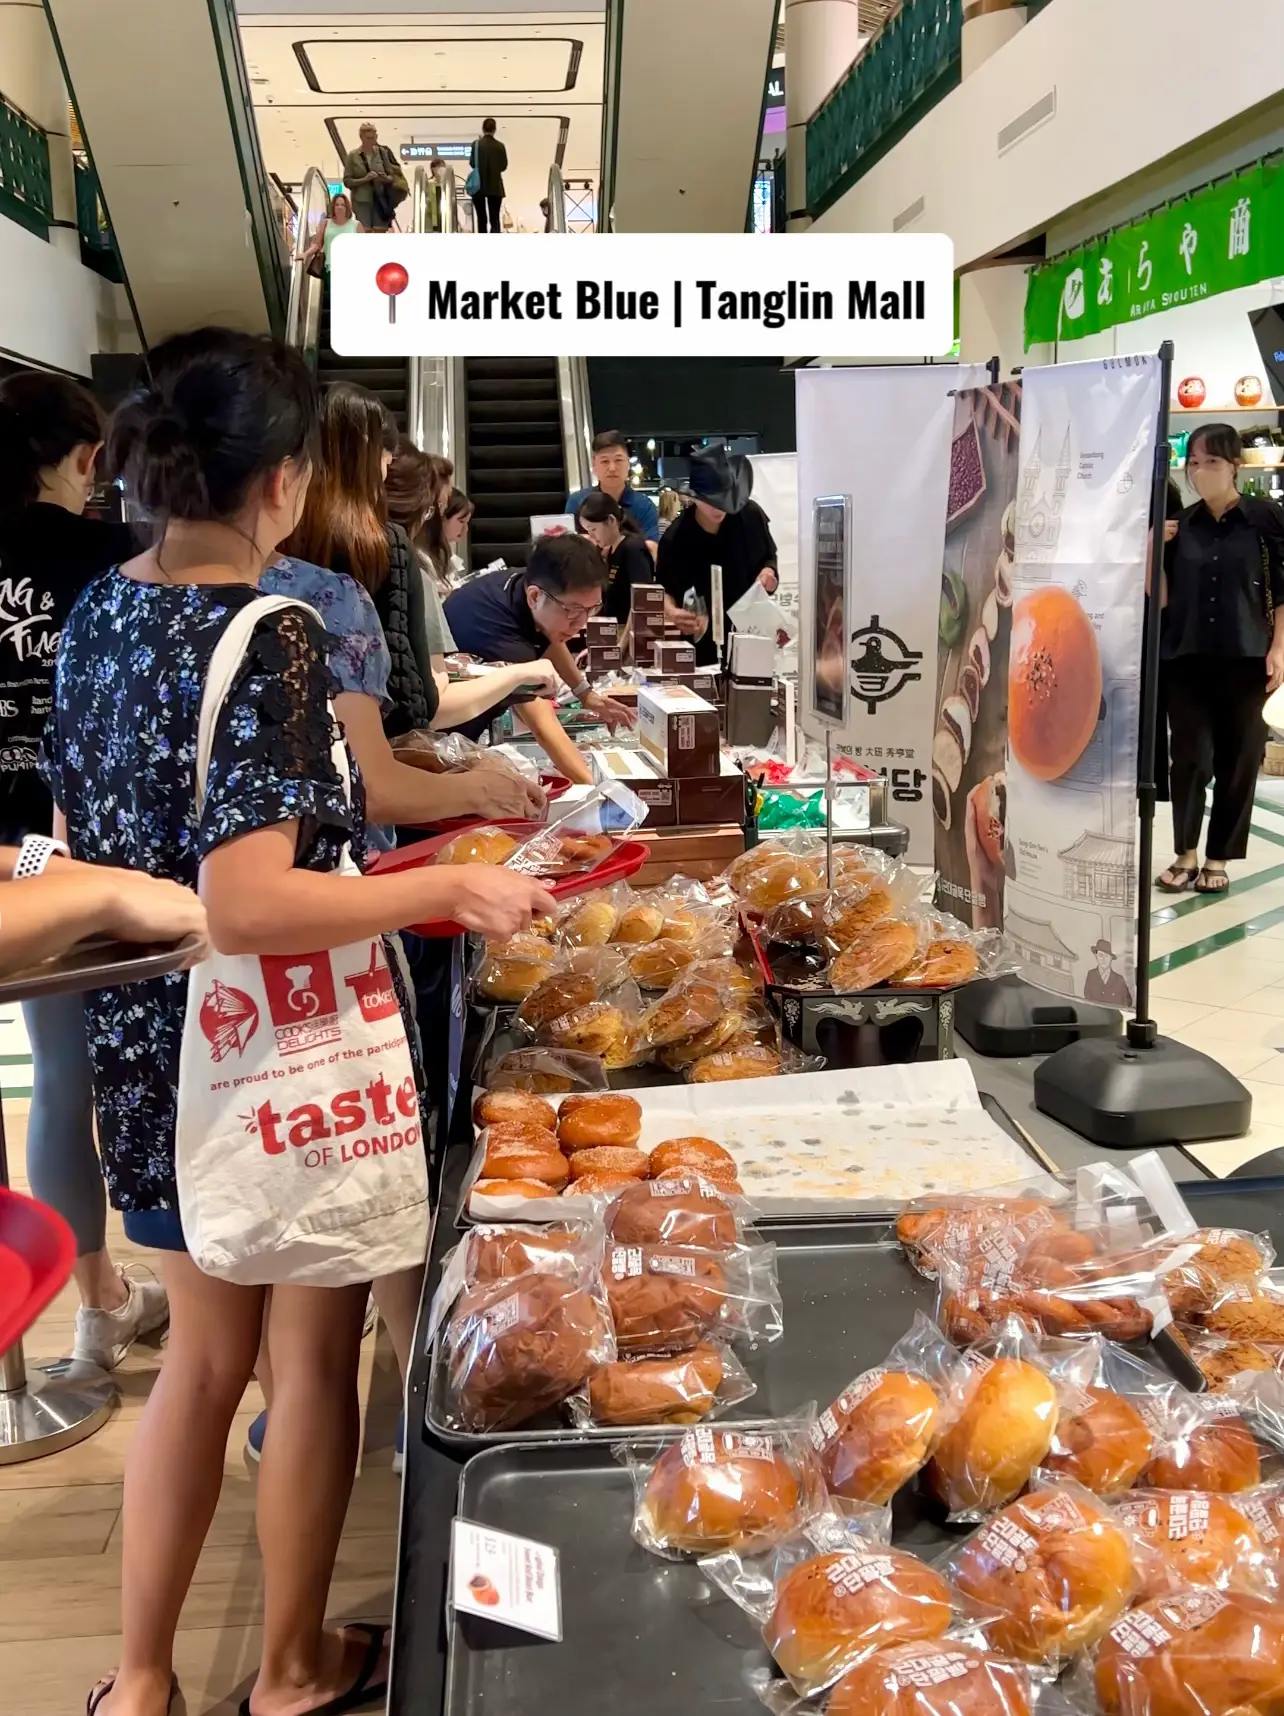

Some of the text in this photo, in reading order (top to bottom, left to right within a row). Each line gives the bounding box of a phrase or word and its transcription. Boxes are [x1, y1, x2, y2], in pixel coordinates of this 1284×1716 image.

[210, 1080, 230, 1091] are
[233, 1071, 269, 1088] proud
[272, 1069, 285, 1079] to
[289, 1063, 304, 1075] be
[308, 1058, 325, 1070] one
[329, 1052, 342, 1063] of
[343, 1046, 363, 1059] the
[257, 1072, 417, 1155] taste
[305, 1147, 333, 1168] OF
